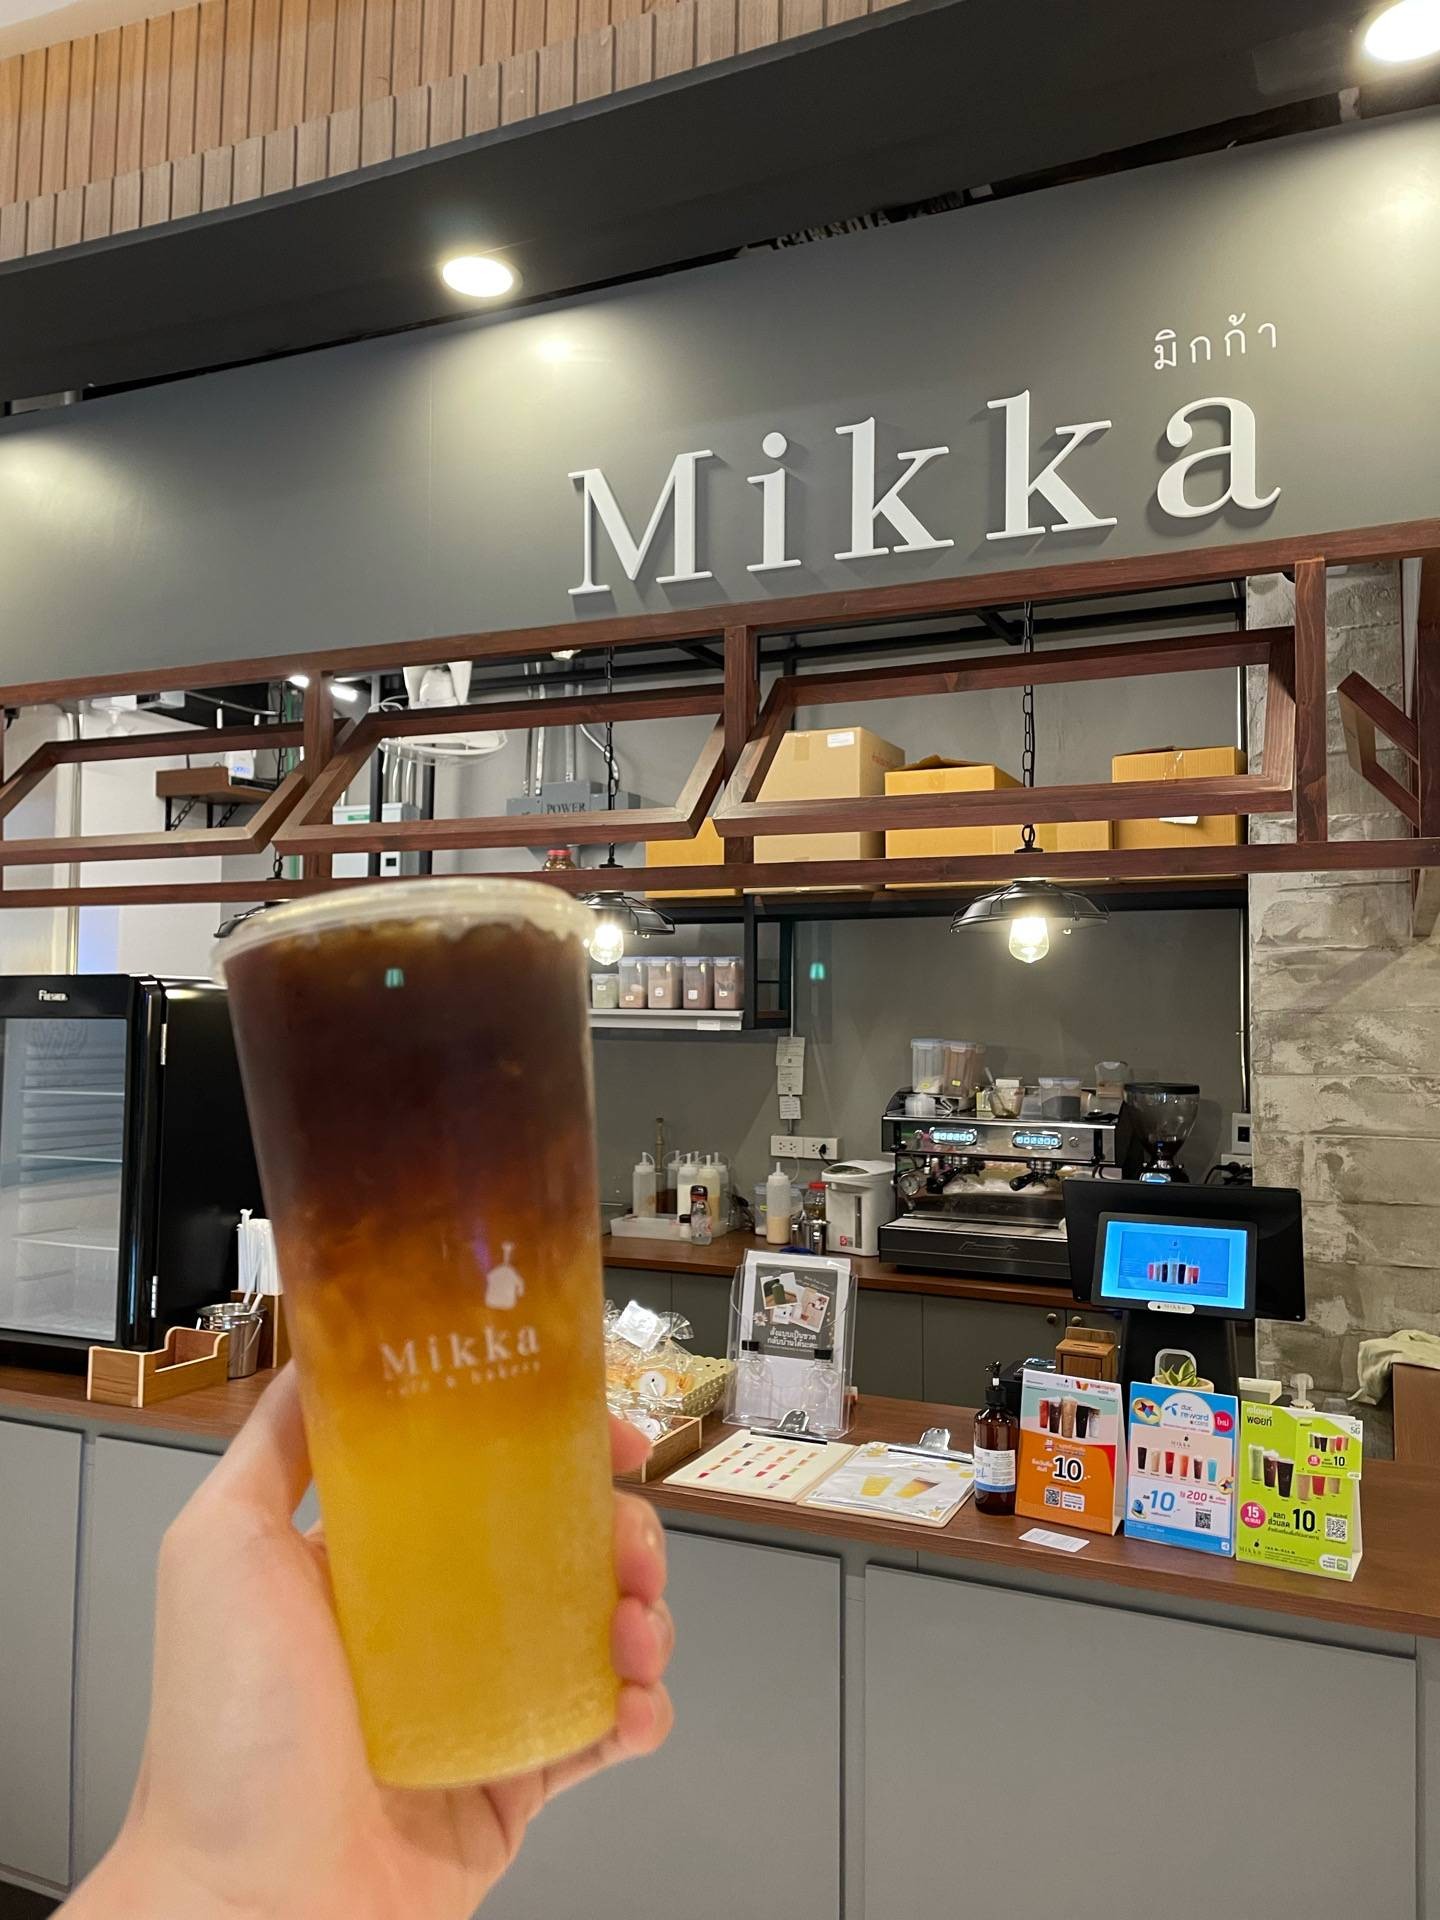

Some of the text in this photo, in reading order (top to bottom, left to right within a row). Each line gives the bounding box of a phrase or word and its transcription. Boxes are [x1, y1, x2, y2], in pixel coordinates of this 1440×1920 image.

[1154, 312, 1277, 370] มิกก้า
[567, 389, 1282, 596] Mikka
[380, 1323, 541, 1382] Mikka
[1186, 1490, 1207, 1502] 200
[1247, 1505, 1260, 1518] 15
